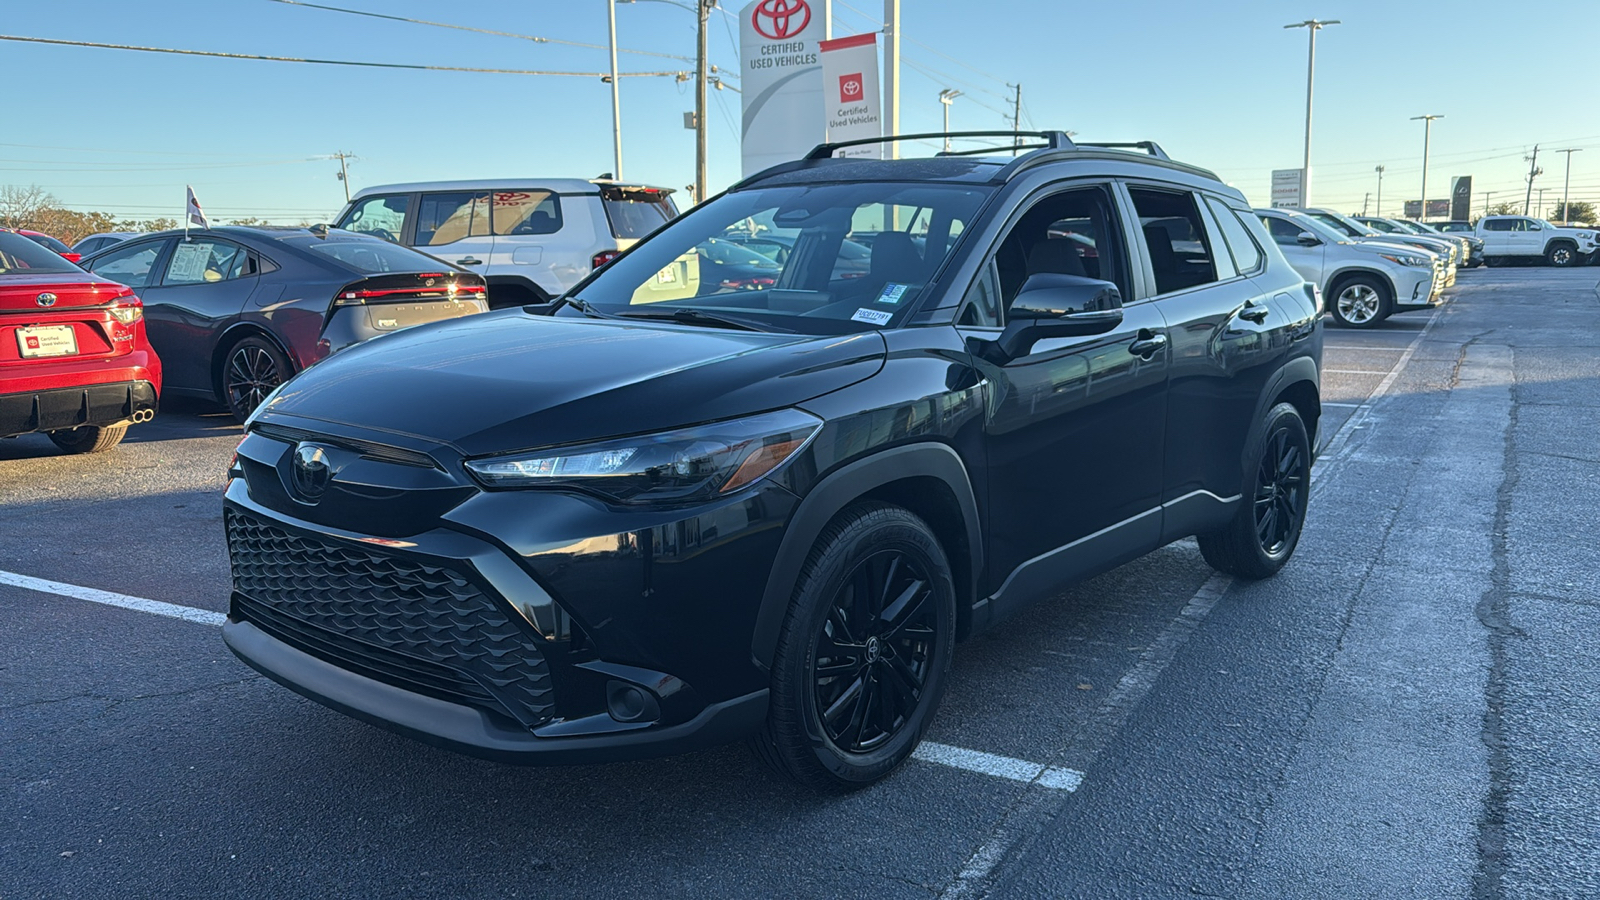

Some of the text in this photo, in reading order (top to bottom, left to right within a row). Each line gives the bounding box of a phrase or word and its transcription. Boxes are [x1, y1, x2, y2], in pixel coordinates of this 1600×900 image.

[761, 42, 804, 55] CERTIFIED
[750, 53, 817, 70] USED VEHICLES
[837, 105, 868, 117] Certified
[829, 114, 878, 128] Used Vehicles
